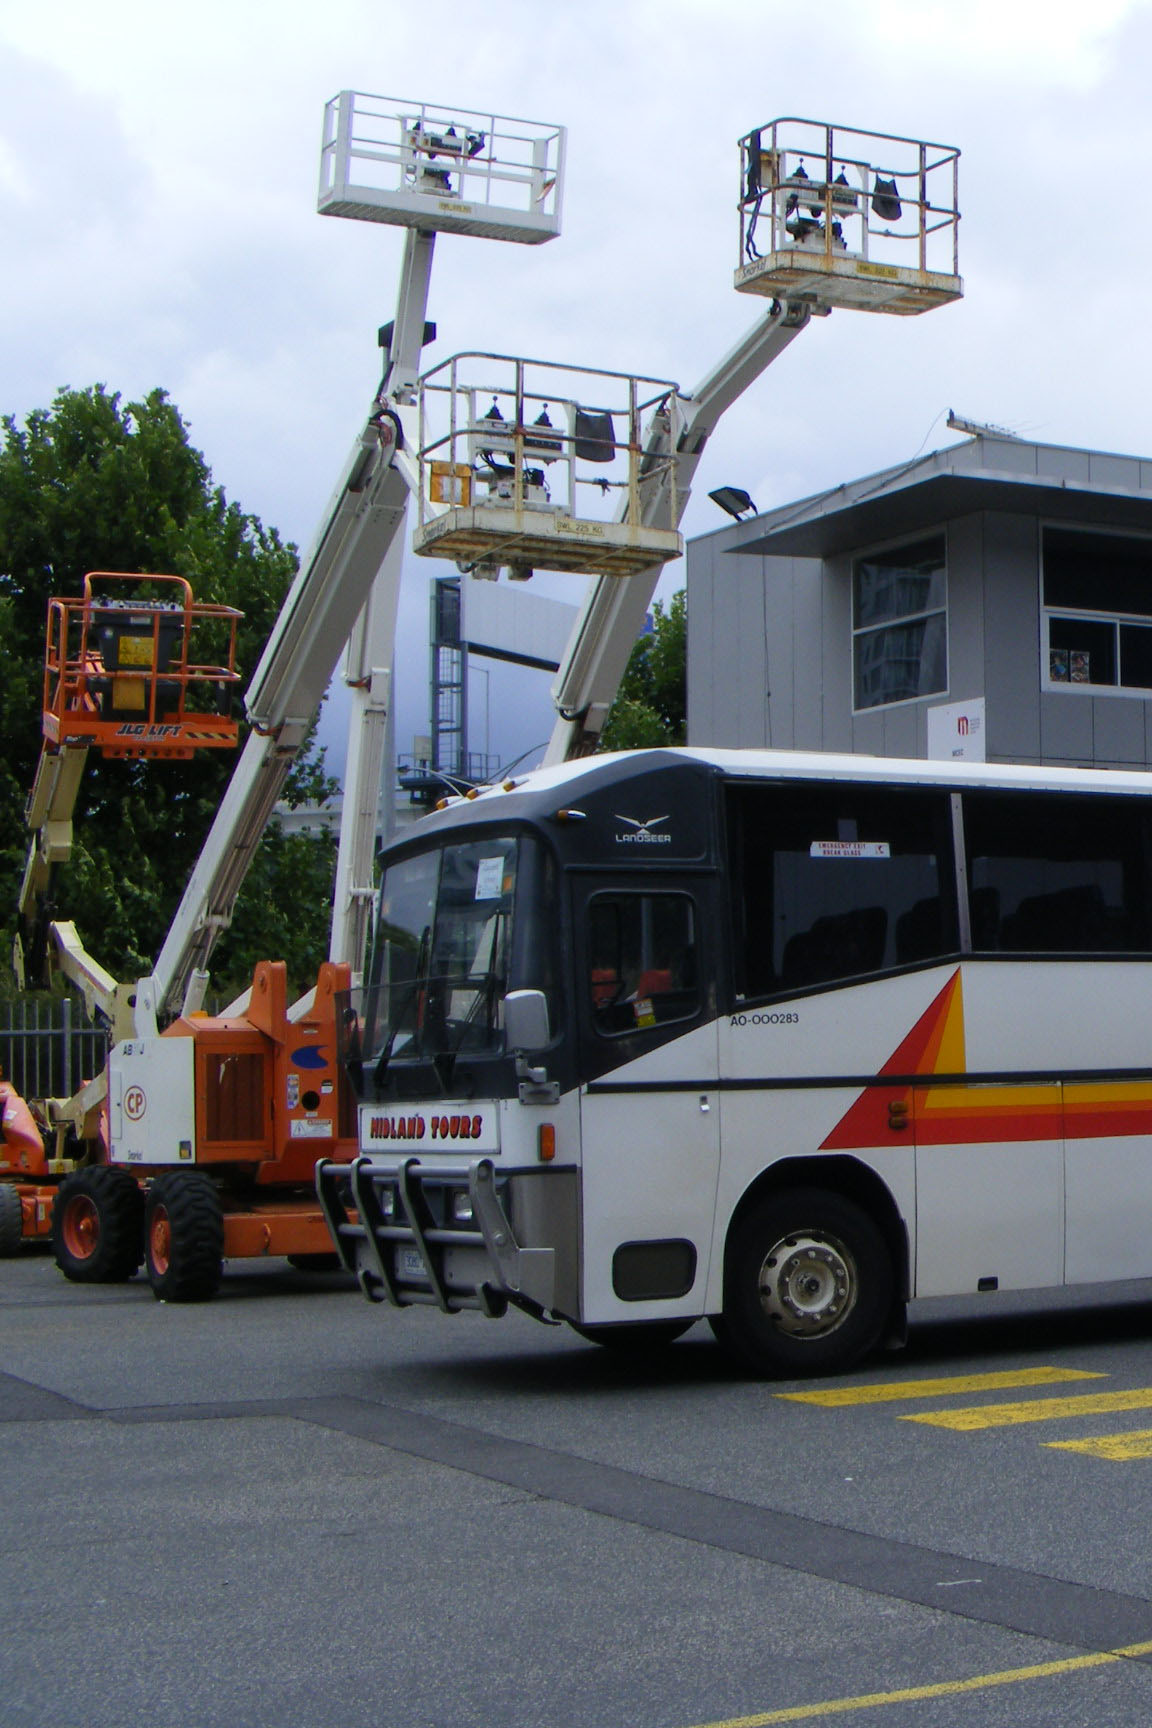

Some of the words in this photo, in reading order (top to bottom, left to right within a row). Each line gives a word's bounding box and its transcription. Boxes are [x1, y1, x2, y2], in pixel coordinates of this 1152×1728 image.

[115, 724, 145, 736] JLG
[149, 725, 182, 737] LIFT
[615, 834, 672, 843] LANDSEER
[127, 1093, 143, 1113] CP
[370, 1116, 425, 1139] MIDLAND
[431, 1114, 483, 1139] TOURS
